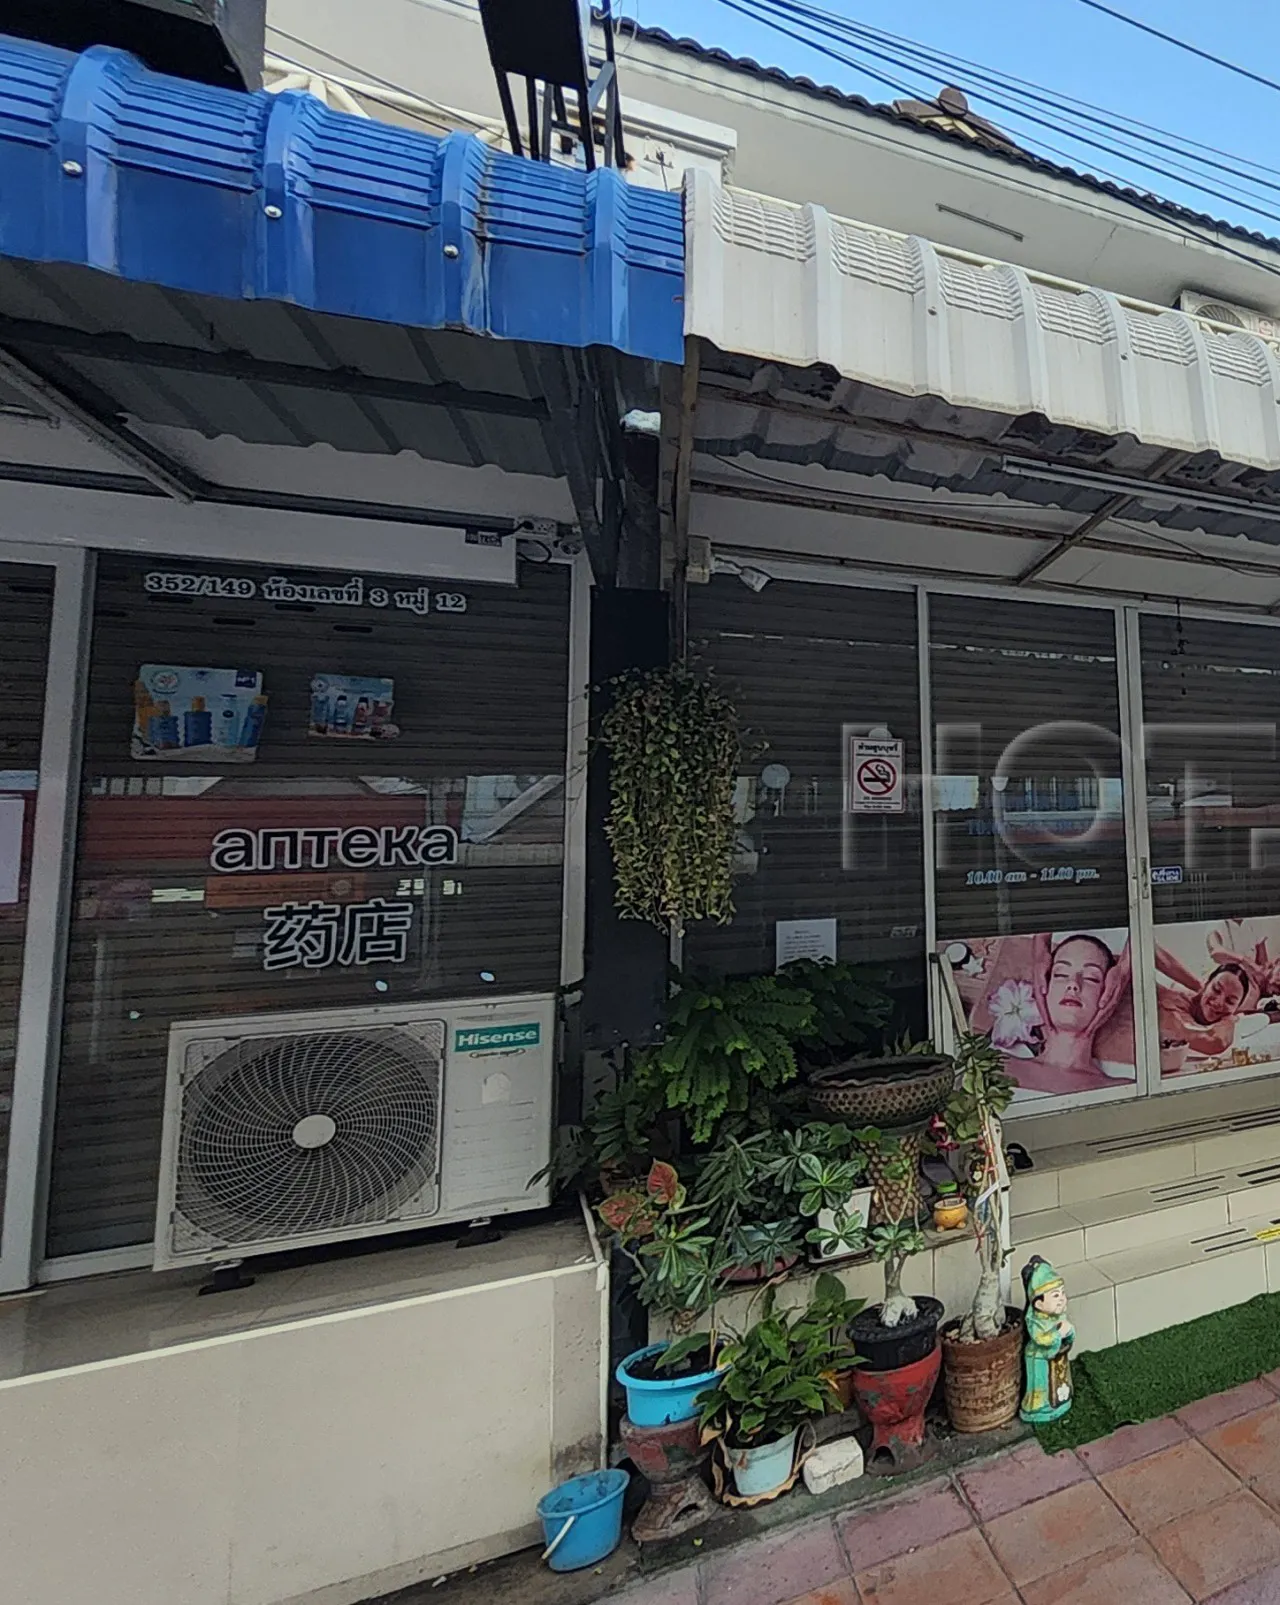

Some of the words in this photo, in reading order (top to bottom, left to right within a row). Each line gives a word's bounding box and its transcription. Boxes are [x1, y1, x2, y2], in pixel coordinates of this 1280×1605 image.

[144, 572, 256, 598] 352/149
[262, 575, 364, 605] ห้องเลขที่
[368, 588, 388, 607] 3
[394, 586, 429, 615] หมู่
[436, 592, 466, 612] 12
[210, 825, 459, 872] аптека
[966, 869, 1003, 885] 10.00
[263, 898, 413, 971] 药店
[459, 1030, 537, 1047] Hisense
